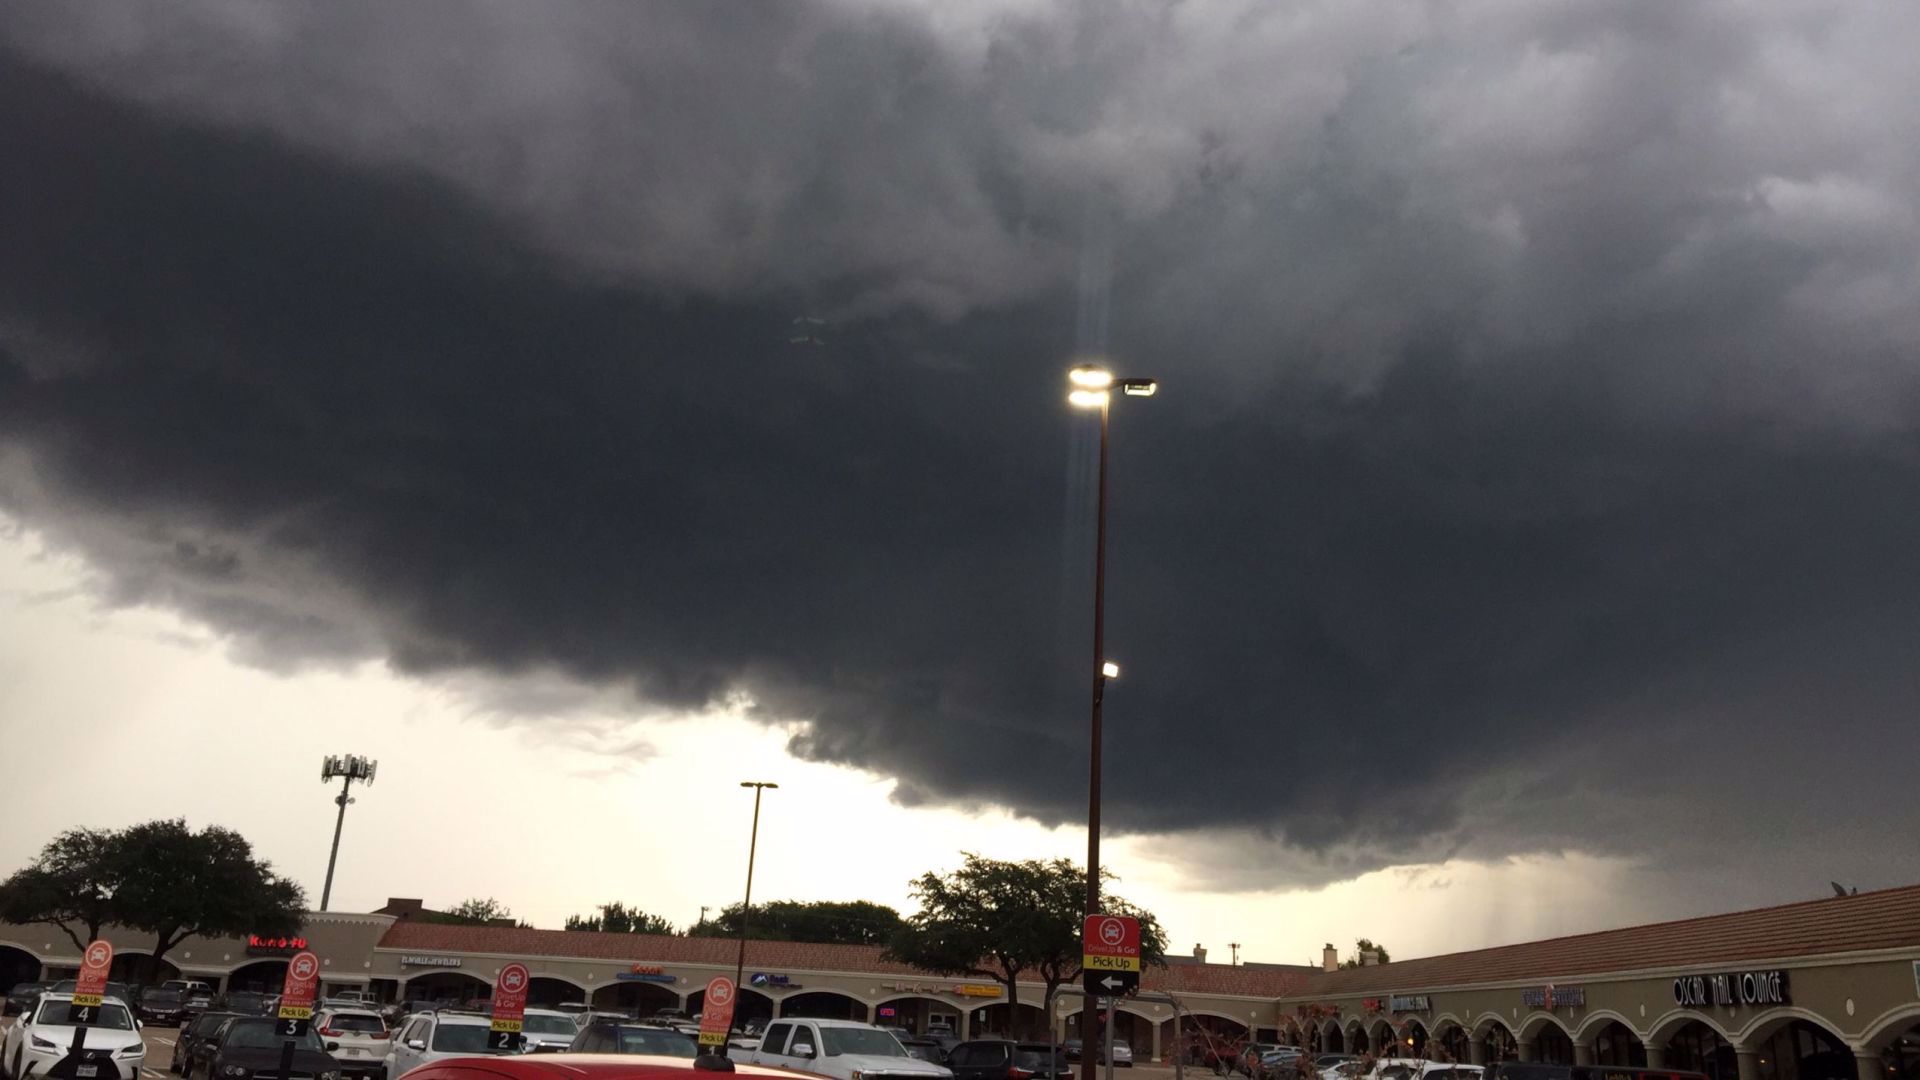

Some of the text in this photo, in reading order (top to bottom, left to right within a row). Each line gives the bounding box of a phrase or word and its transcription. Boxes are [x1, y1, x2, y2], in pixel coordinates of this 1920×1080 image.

[1124, 946, 1136, 954] Go
[1093, 956, 1131, 970] Pick Up
[1673, 976, 1706, 1005] OSCAR
[1738, 971, 1782, 1004] LOUNGE
[74, 994, 90, 1003] Pick
[78, 1006, 89, 1022] 4
[281, 1007, 309, 1017] Pick Up
[286, 1019, 298, 1035] 3
[492, 1020, 521, 1031] Pick Up
[498, 1032, 510, 1049] 2
[701, 1032, 716, 1041] Pick
